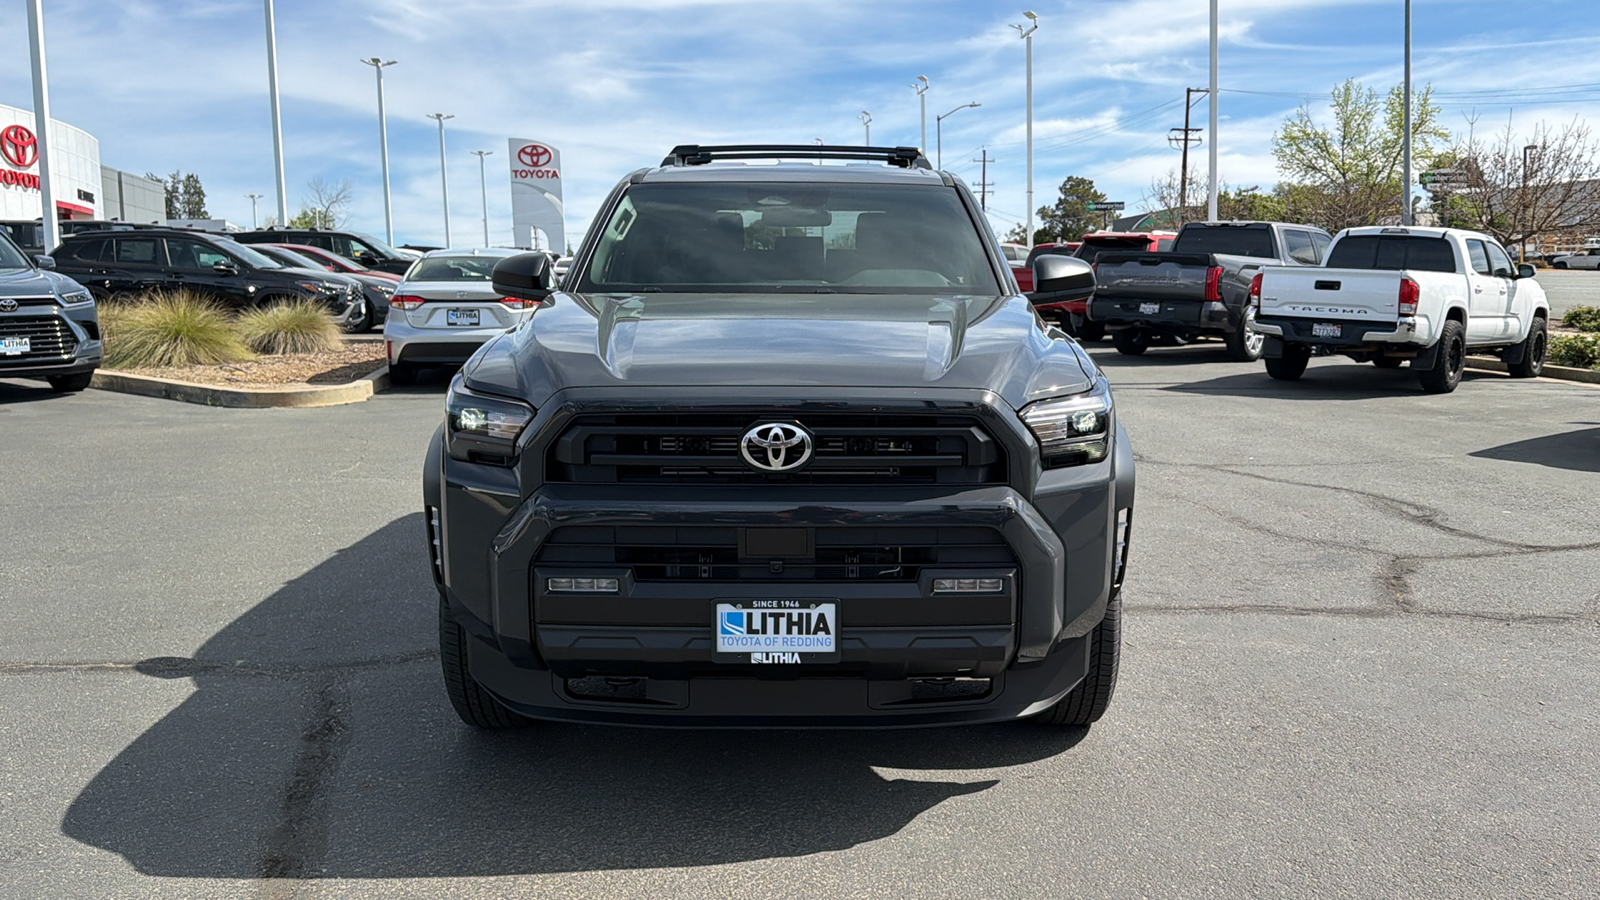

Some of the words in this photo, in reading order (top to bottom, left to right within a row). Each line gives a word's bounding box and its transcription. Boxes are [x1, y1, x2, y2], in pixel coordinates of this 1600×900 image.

[512, 169, 560, 179] TOYOTA
[0, 168, 41, 191] TOYOT
[1289, 305, 1368, 315] TACOMA
[3, 339, 29, 348] LITHIA
[752, 600, 778, 608] SINCE
[780, 600, 800, 608] 1946
[746, 612, 831, 636] LITHIA
[721, 636, 762, 647] TOYOTA
[764, 636, 779, 647] OF
[782, 637, 832, 647] REDDING
[762, 652, 801, 664] LITHIA
